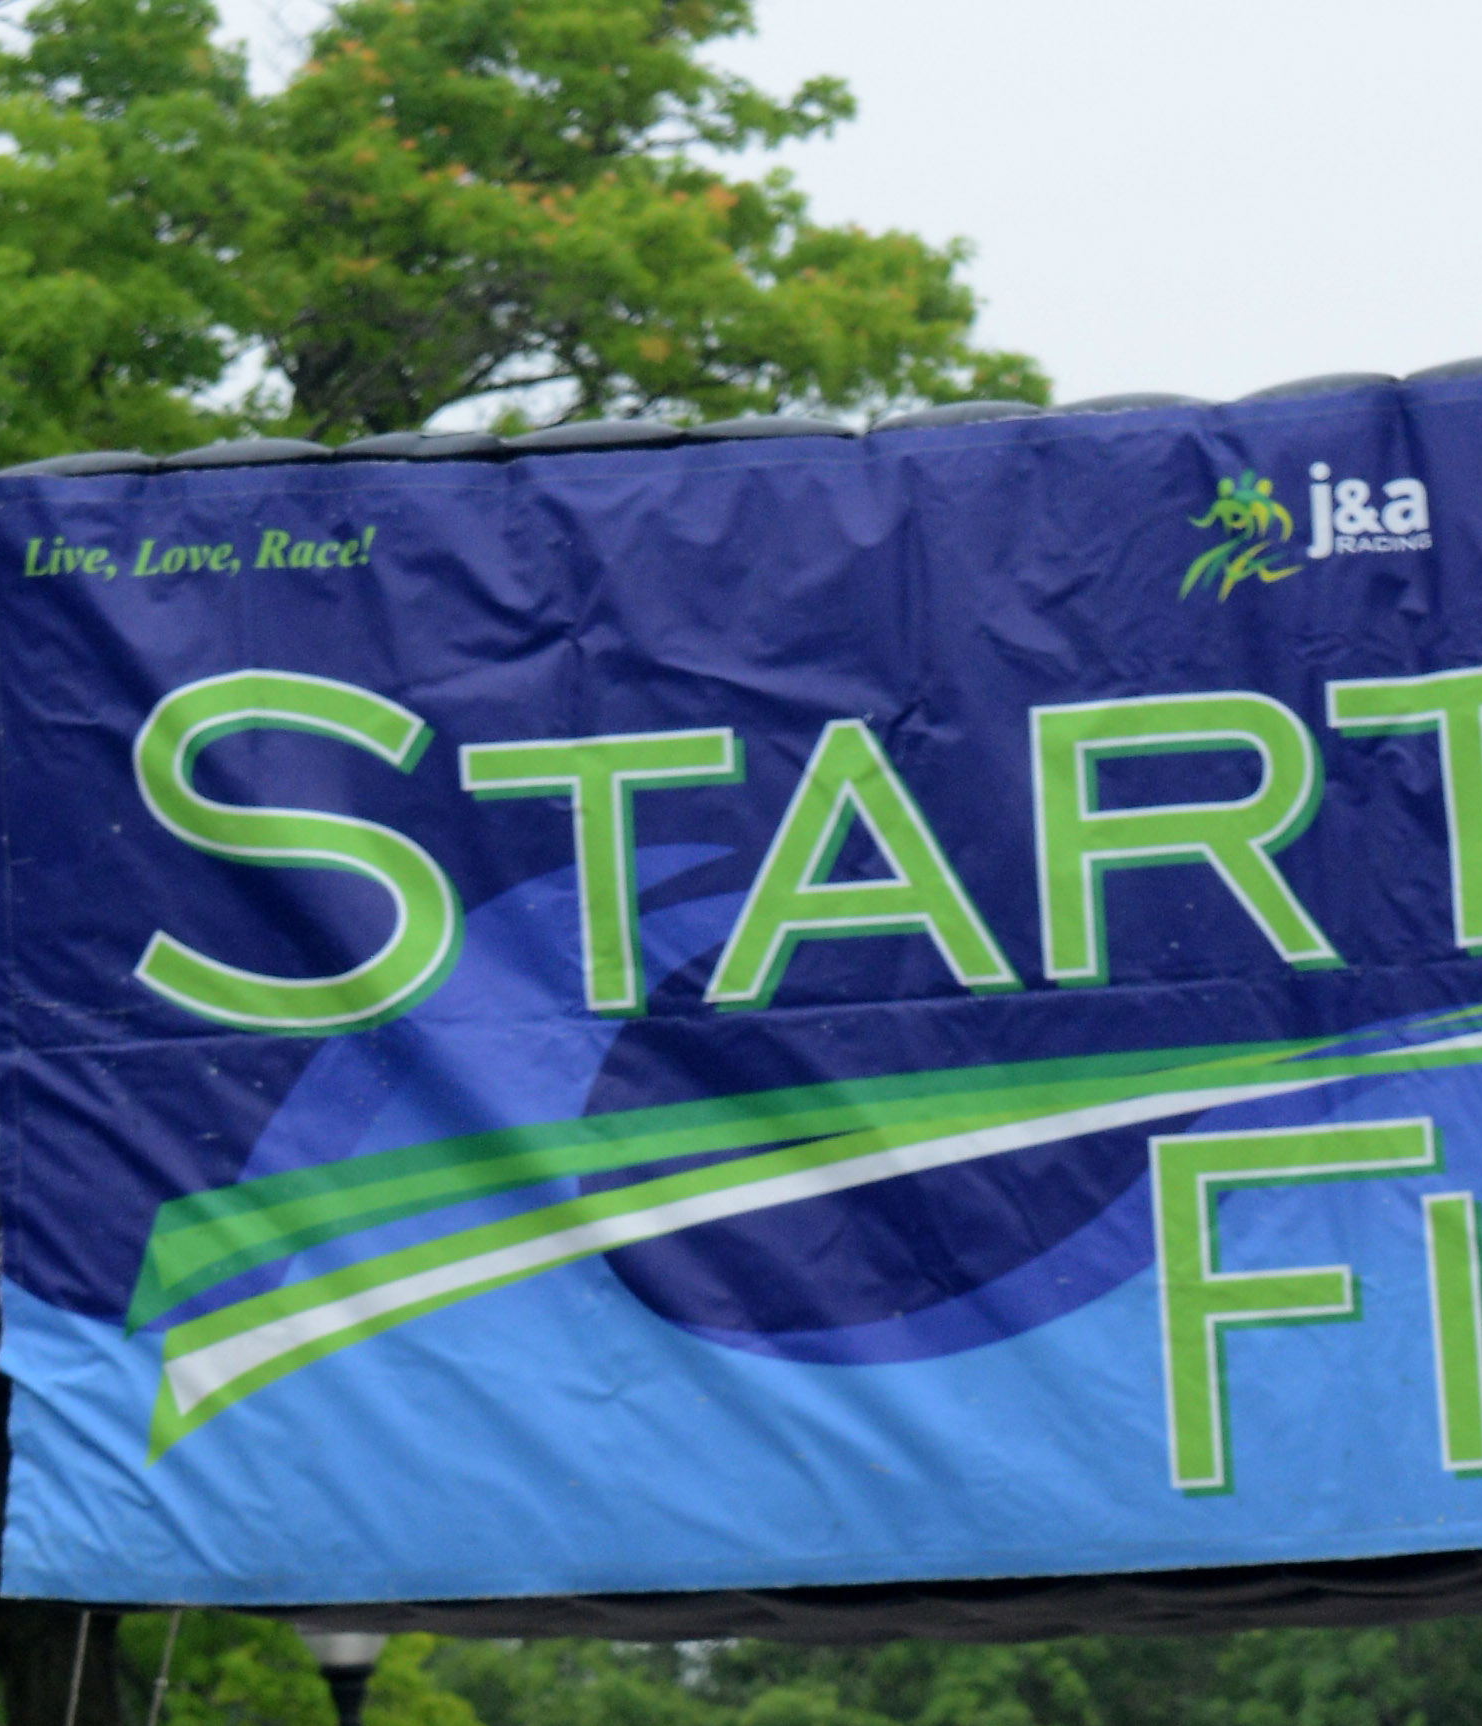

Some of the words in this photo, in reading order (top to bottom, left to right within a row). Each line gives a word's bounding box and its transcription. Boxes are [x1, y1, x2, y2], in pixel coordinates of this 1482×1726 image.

[1306, 461, 1431, 559] j&a
[24, 536, 118, 581] Live,
[132, 538, 242, 577] Love,
[255, 525, 377, 570] Race!
[1334, 532, 1433, 554] RACING
